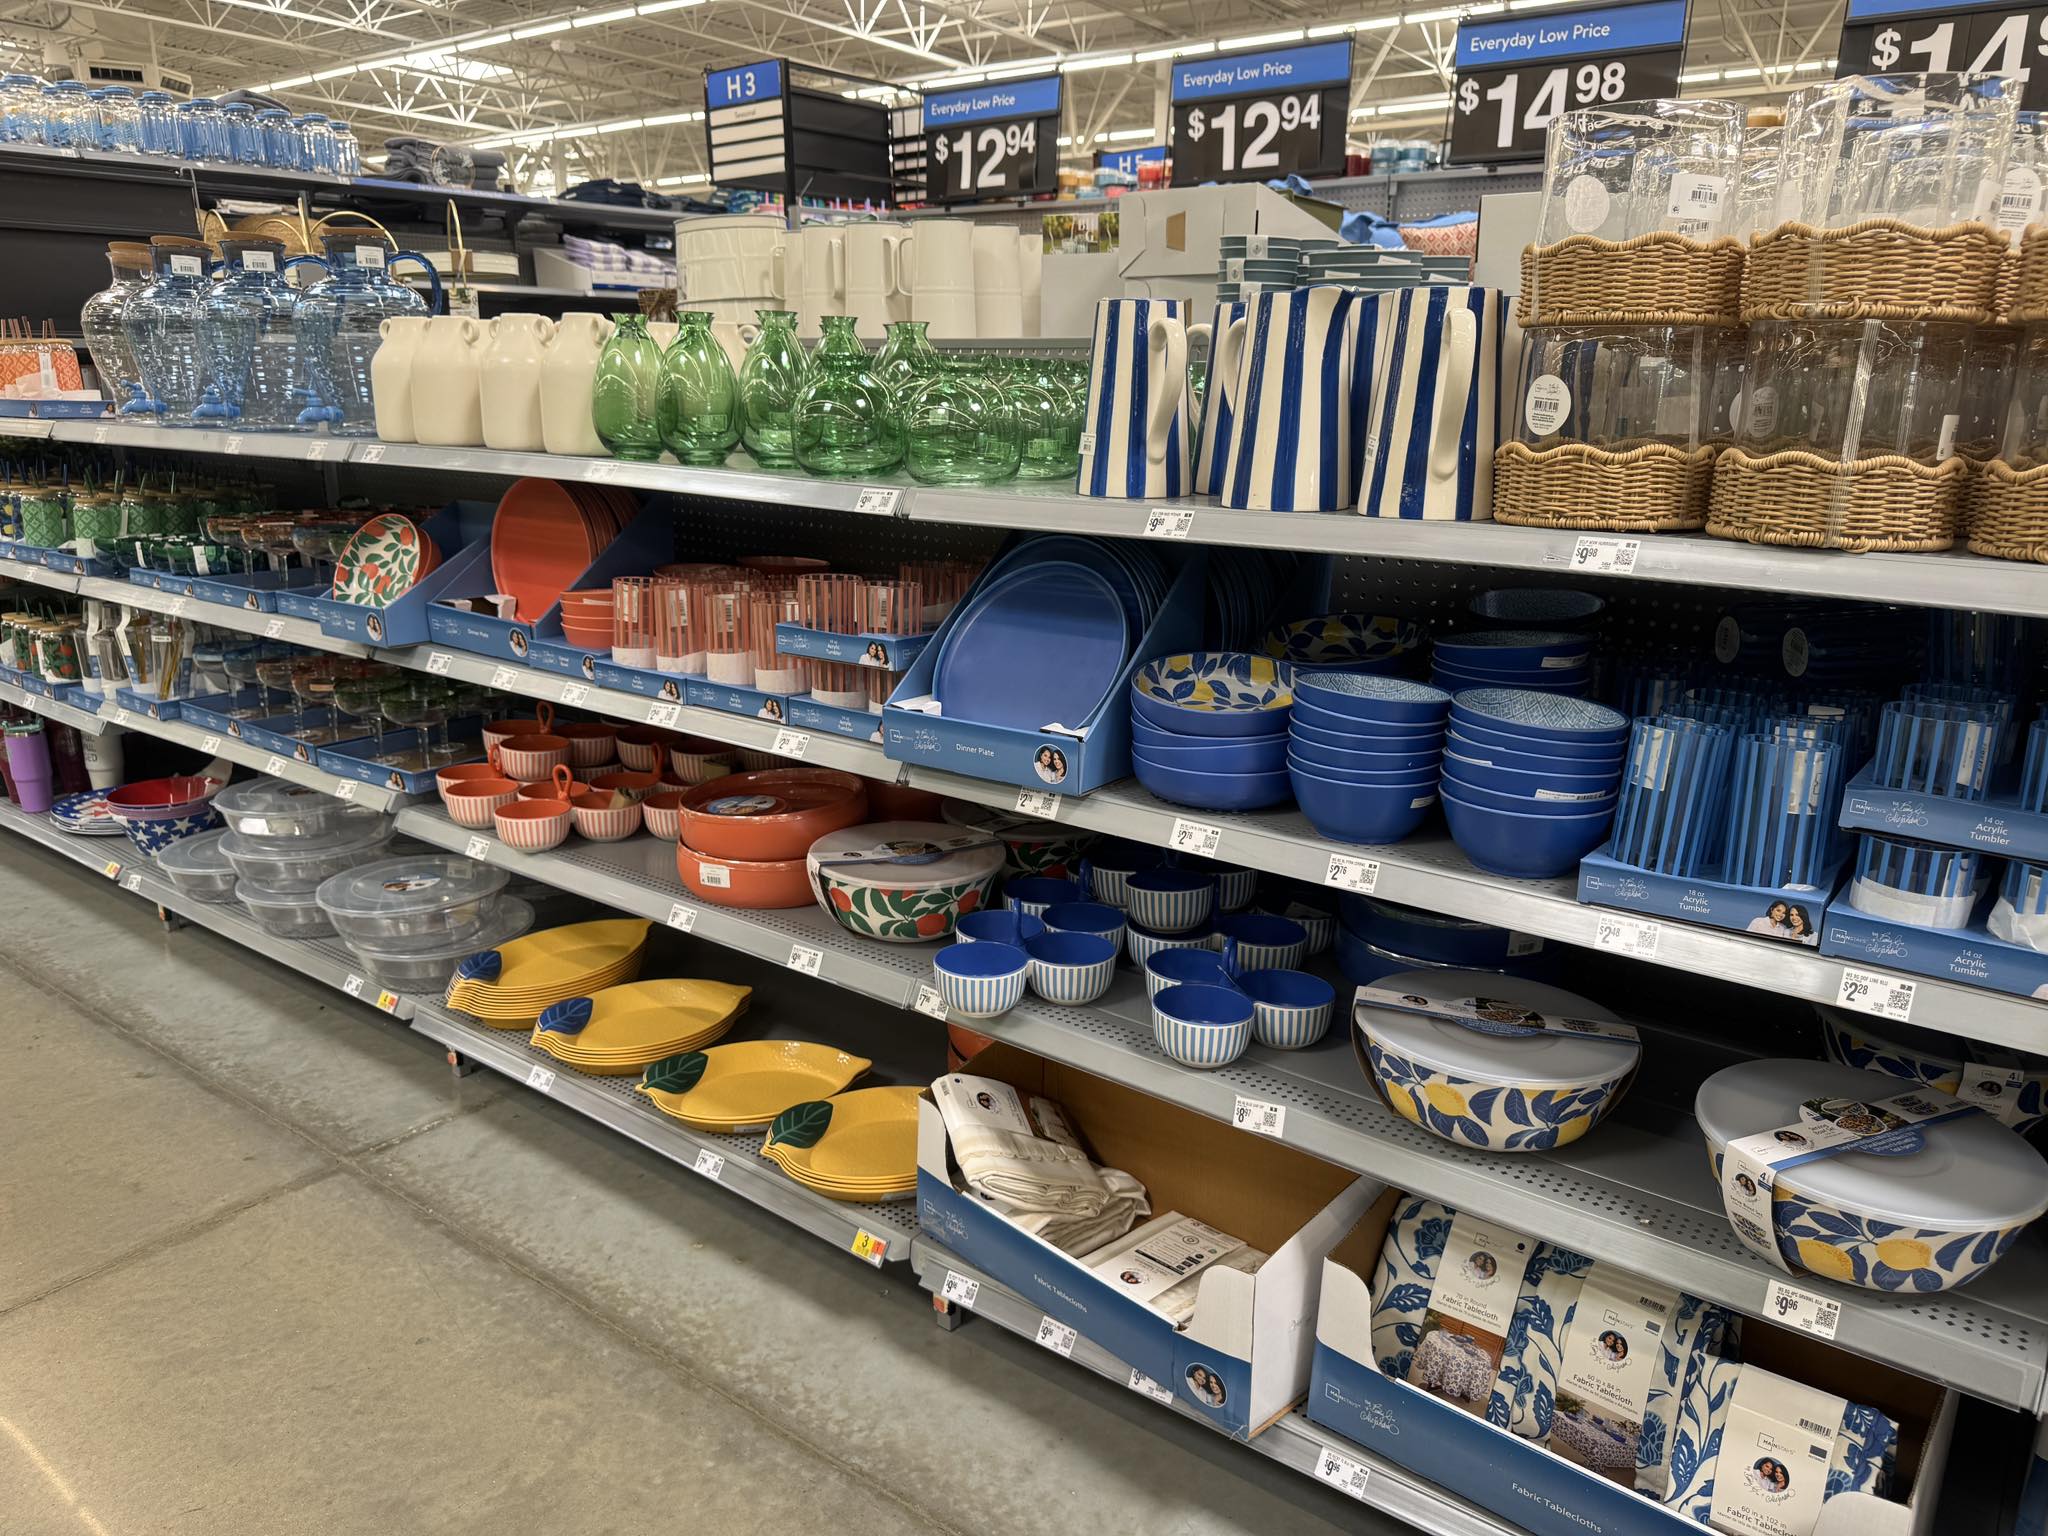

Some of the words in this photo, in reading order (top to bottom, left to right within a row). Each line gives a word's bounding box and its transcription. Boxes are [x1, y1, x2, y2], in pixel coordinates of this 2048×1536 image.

[1471, 33, 1536, 52] Everyday
[1539, 27, 1569, 45] Low
[1573, 22, 1611, 40] Price
[1183, 71, 1234, 89] Everyday
[1237, 67, 1259, 82] Low
[1263, 62, 1293, 77] Price
[931, 100, 971, 117] Everyday
[972, 97, 990, 111] Low
[992, 94, 1016, 108] Price
[956, 743, 977, 754] Dinner
[978, 747, 995, 757] Plate
[1983, 816, 1993, 824] 14
[1994, 818, 2004, 826] oz
[1975, 823, 2009, 836] Acrylic
[1970, 831, 2011, 846] Tumbler
[1683, 895, 1709, 906] Acrylic
[1679, 902, 1711, 915] Tumbler
[1962, 949, 1971, 958] 14
[1954, 956, 1987, 969] Acrylic
[1948, 963, 1989, 979] Tumbler
[1441, 1294, 1461, 1307] Fabric
[1463, 1302, 1498, 1321] Tablecloth
[1573, 1374, 1594, 1389] Fabric
[1596, 1384, 1633, 1407] Tablecloth
[1606, 1382, 1615, 1390] 84
[1512, 1482, 1541, 1504] Fabric
[1543, 1498, 1602, 1533] Tablecloths
[1727, 1506, 1753, 1523] Fabric
[1741, 1505, 1750, 1514] 60
[1766, 1515, 1779, 1525] 102
[1779, 1521, 1787, 1530] in
